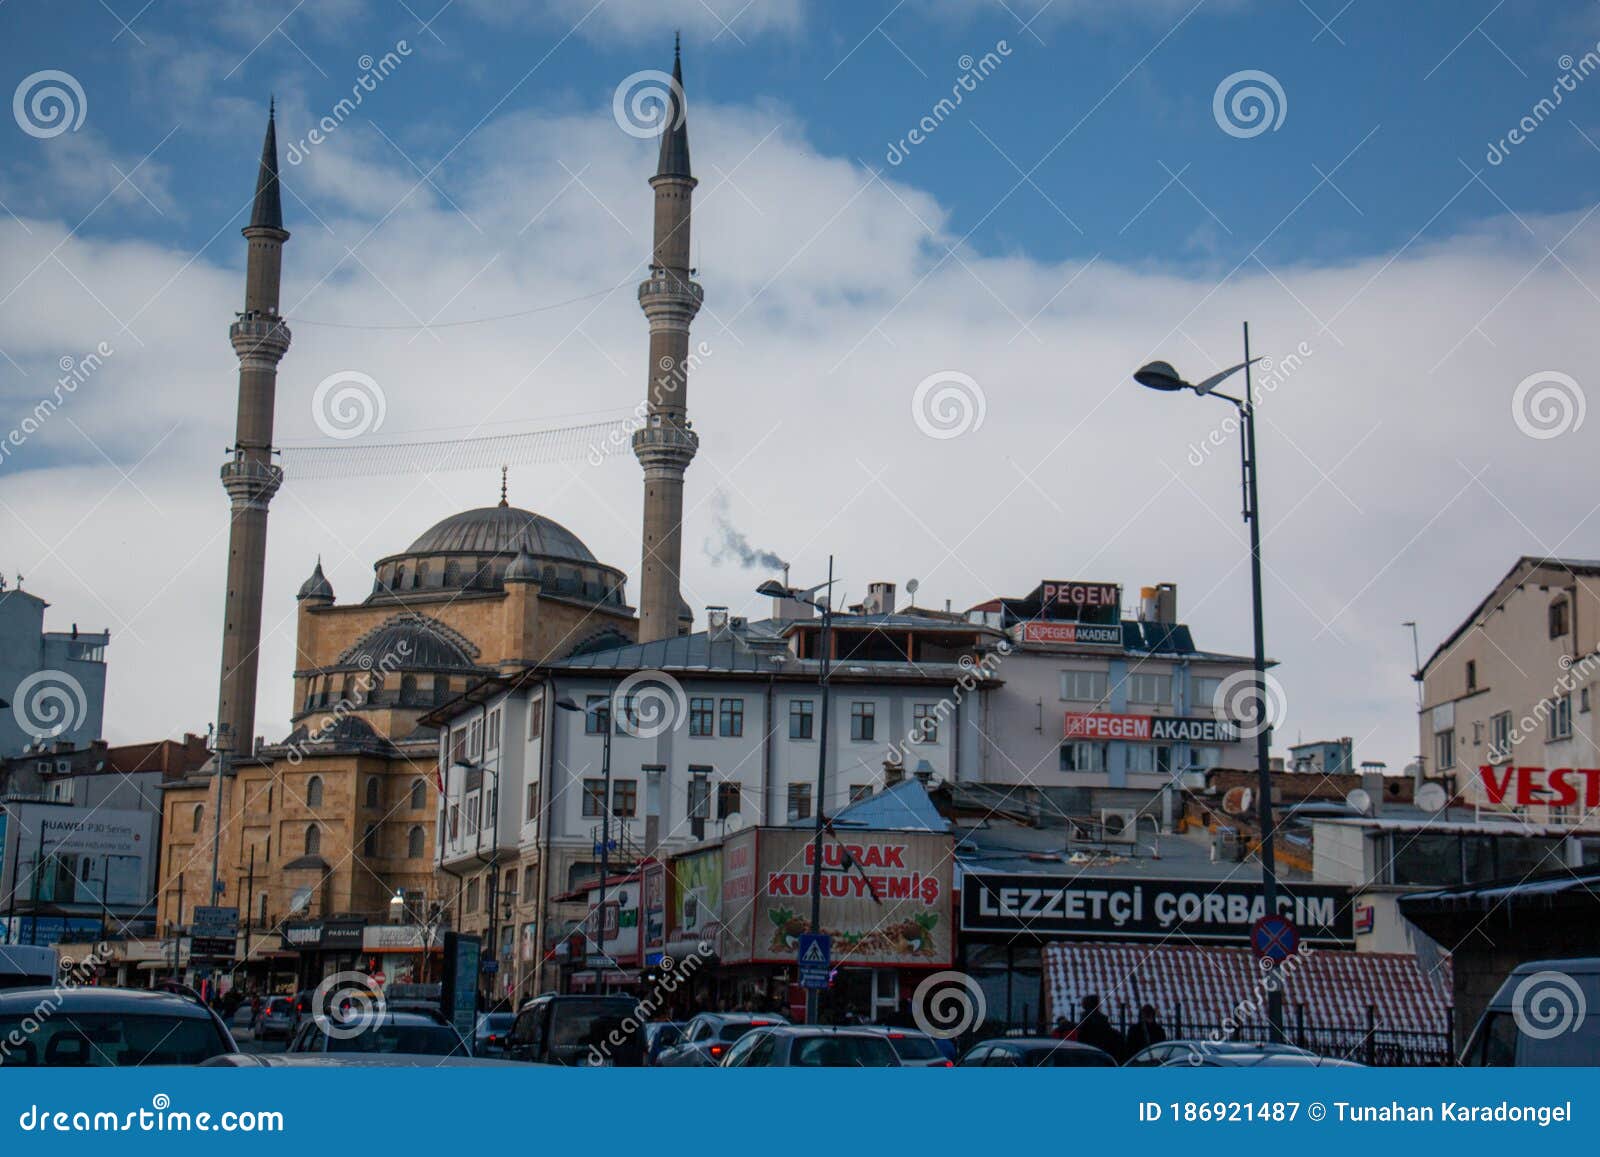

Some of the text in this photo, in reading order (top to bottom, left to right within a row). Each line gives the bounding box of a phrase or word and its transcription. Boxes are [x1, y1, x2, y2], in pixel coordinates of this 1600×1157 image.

[1043, 584, 1116, 605] PEGEM
[1042, 626, 1075, 640] PEGEM
[1085, 717, 1148, 737] PEGEM
[1479, 765, 1600, 808] VEST
[44, 821, 84, 832] HUAWEI
[979, 886, 1142, 925] LEZZETÇİ
